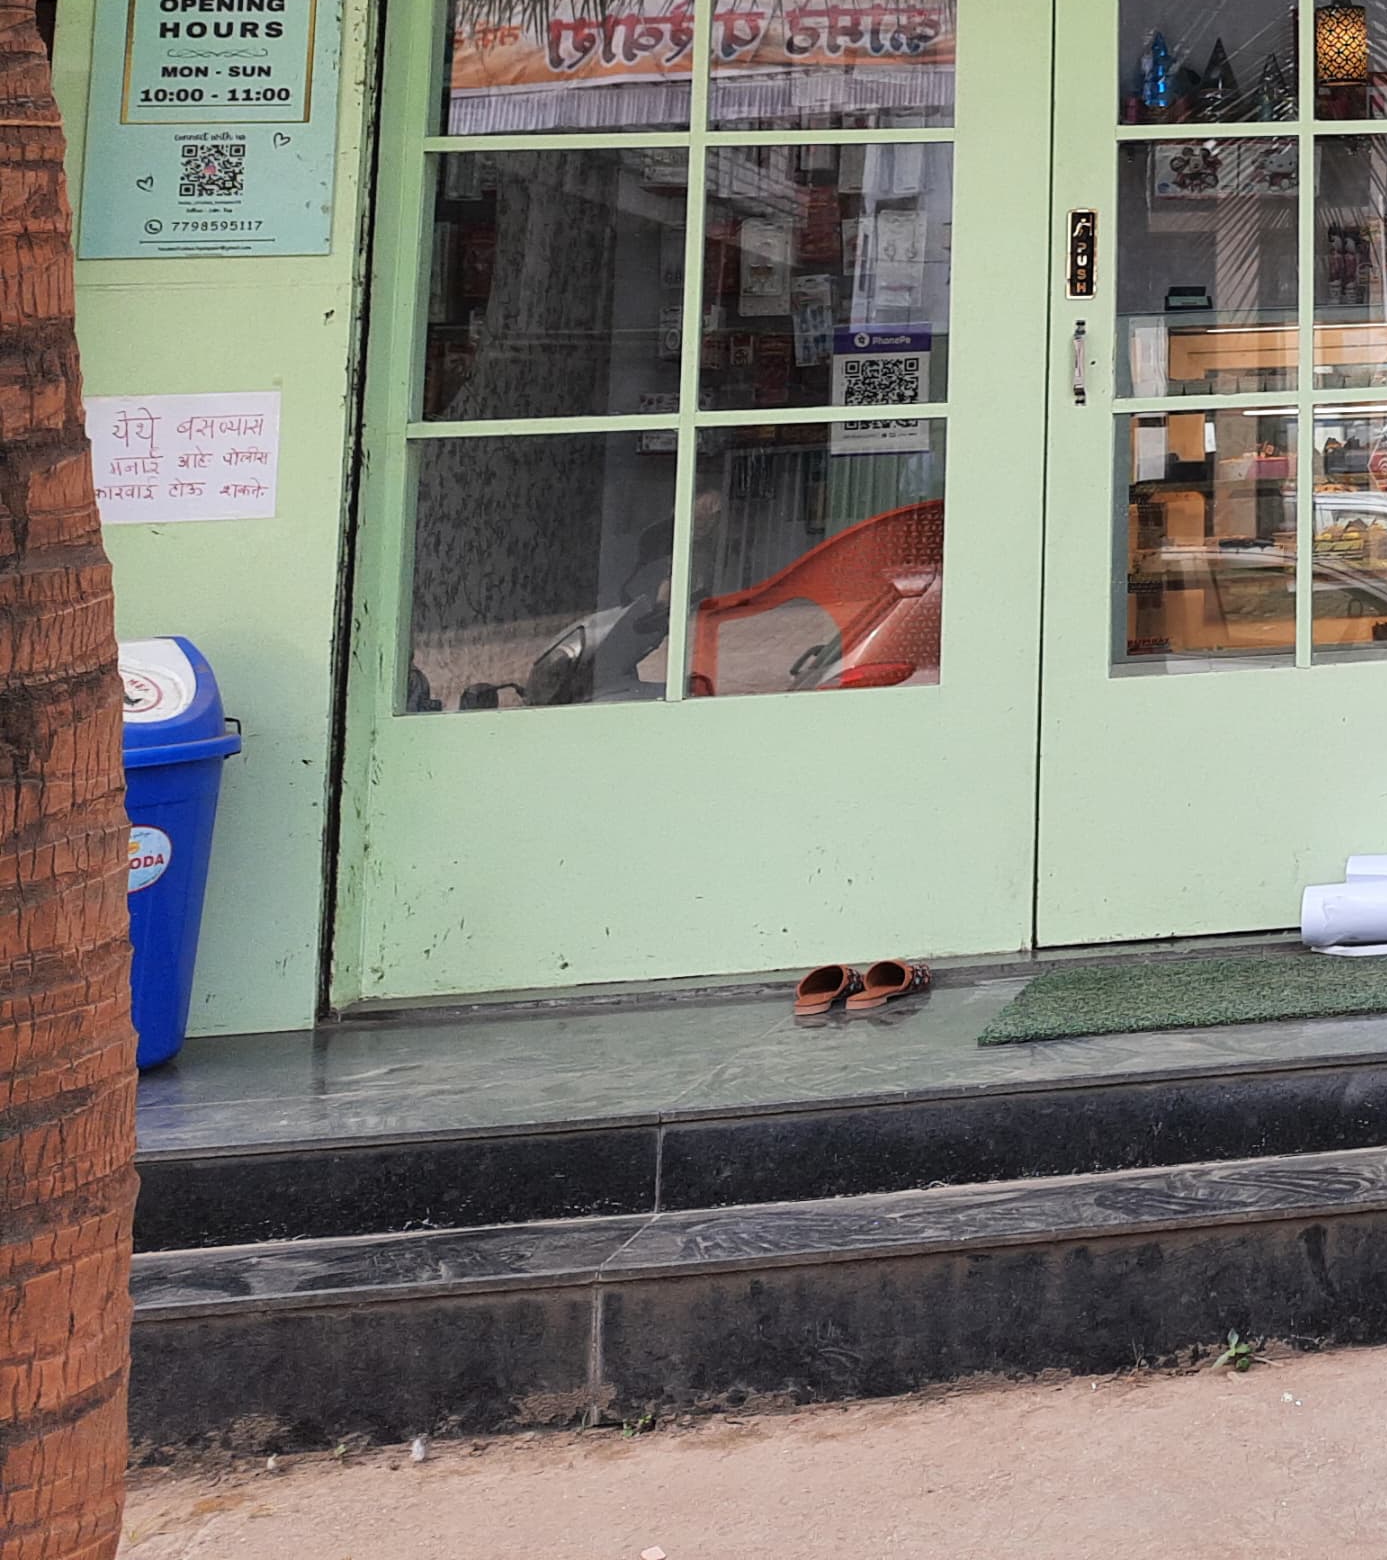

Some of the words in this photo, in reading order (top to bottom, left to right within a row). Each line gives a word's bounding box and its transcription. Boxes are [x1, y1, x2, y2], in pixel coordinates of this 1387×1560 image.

[159, 21, 284, 38] HOURS
[161, 65, 209, 78] MON
[228, 65, 272, 77] SUN
[140, 88, 204, 103] 10:00
[227, 88, 290, 102] 11:00
[171, 221, 263, 232] 7798595117
